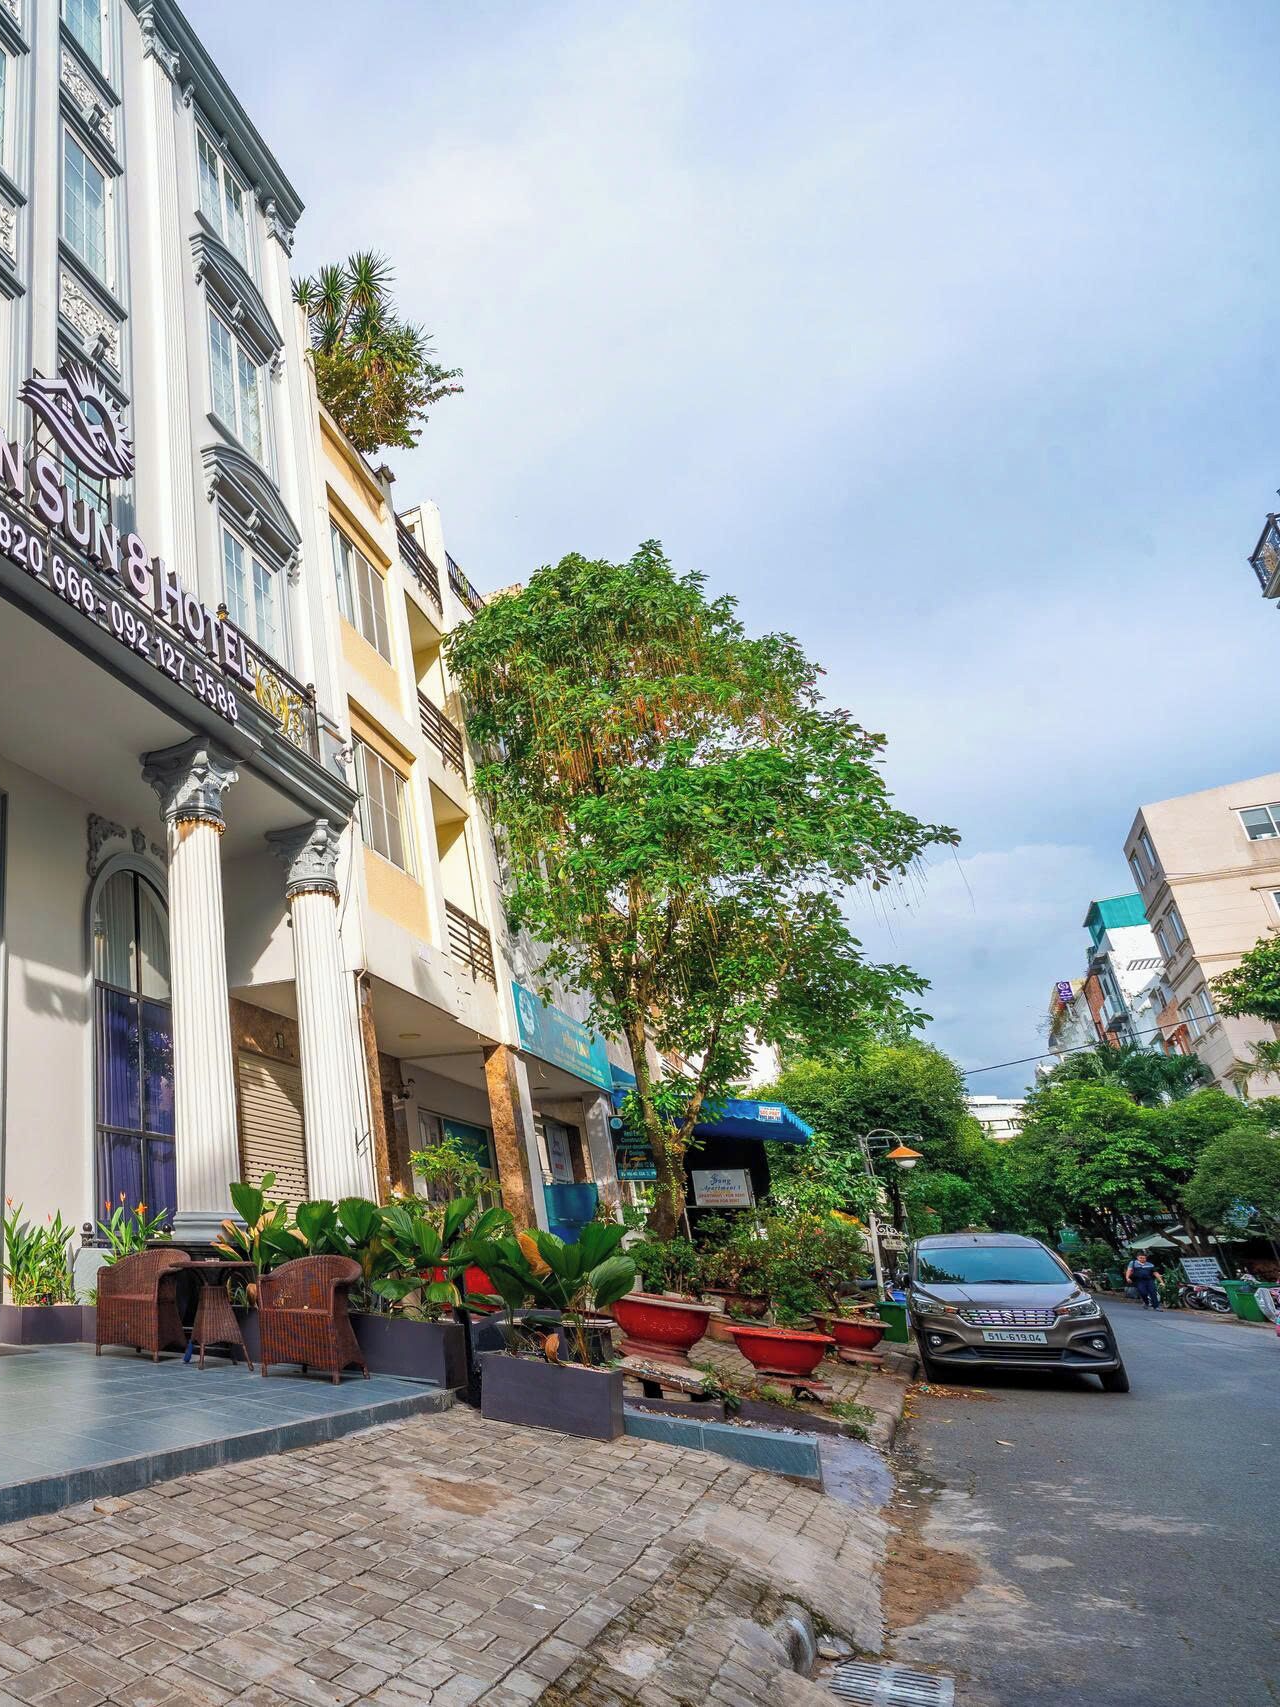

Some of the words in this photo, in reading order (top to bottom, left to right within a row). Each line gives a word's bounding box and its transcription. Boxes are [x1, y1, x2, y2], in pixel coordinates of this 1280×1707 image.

[31, 455, 119, 574] SUN
[152, 557, 256, 691] HOTEL
[156, 636, 186, 681] 127
[193, 664, 239, 722] 5588
